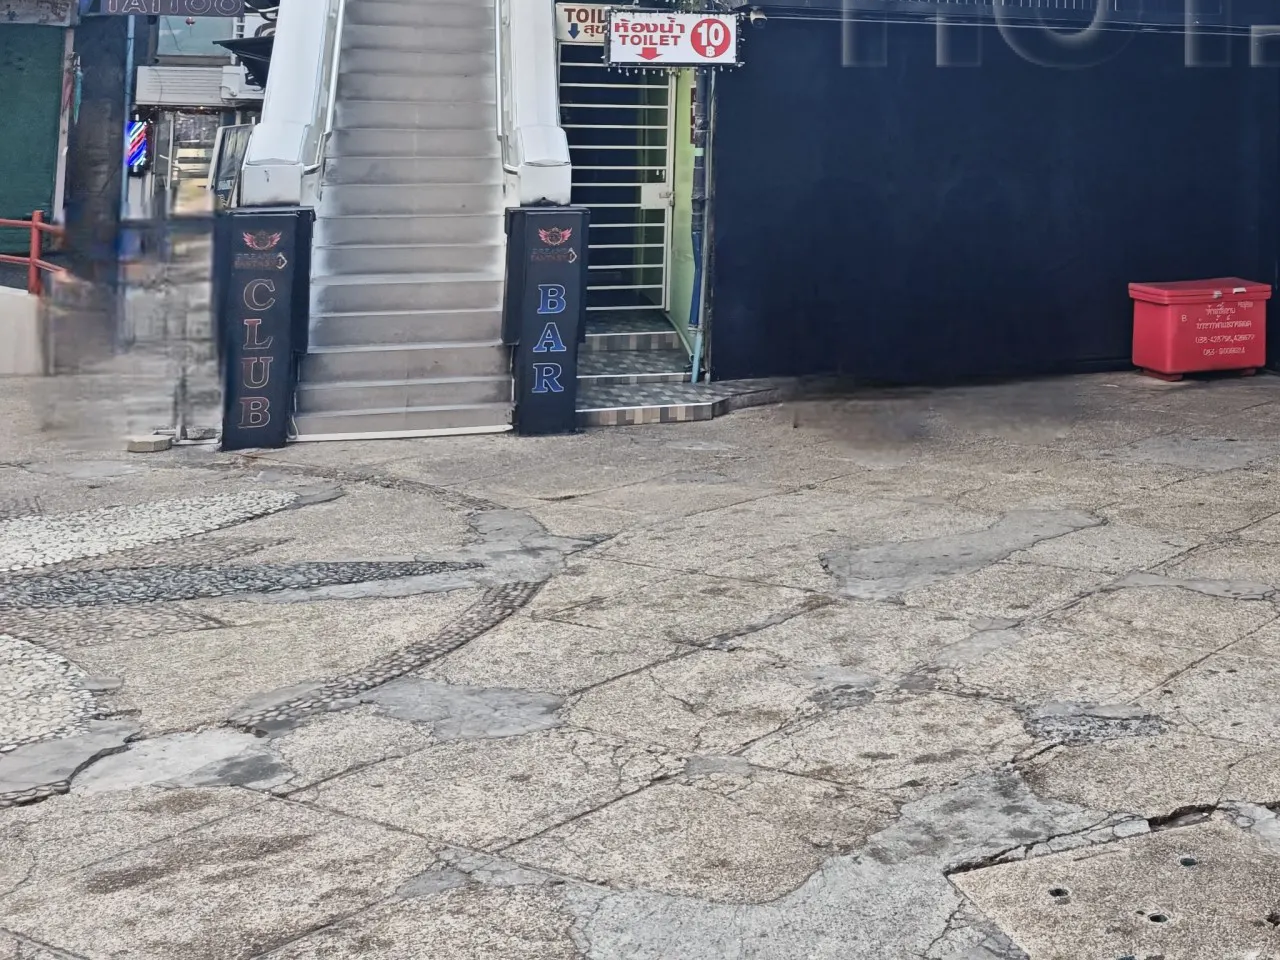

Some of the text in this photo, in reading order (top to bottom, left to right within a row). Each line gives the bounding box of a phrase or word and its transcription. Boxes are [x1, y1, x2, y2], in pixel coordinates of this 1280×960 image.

[564, 8, 607, 24] TOIL
[614, 17, 686, 33] ห้องน้ำ
[618, 34, 681, 46] TOILET
[697, 22, 725, 47] 10
[705, 46, 716, 57] B
[532, 284, 567, 393] BAR
[238, 278, 276, 428] CLUB
